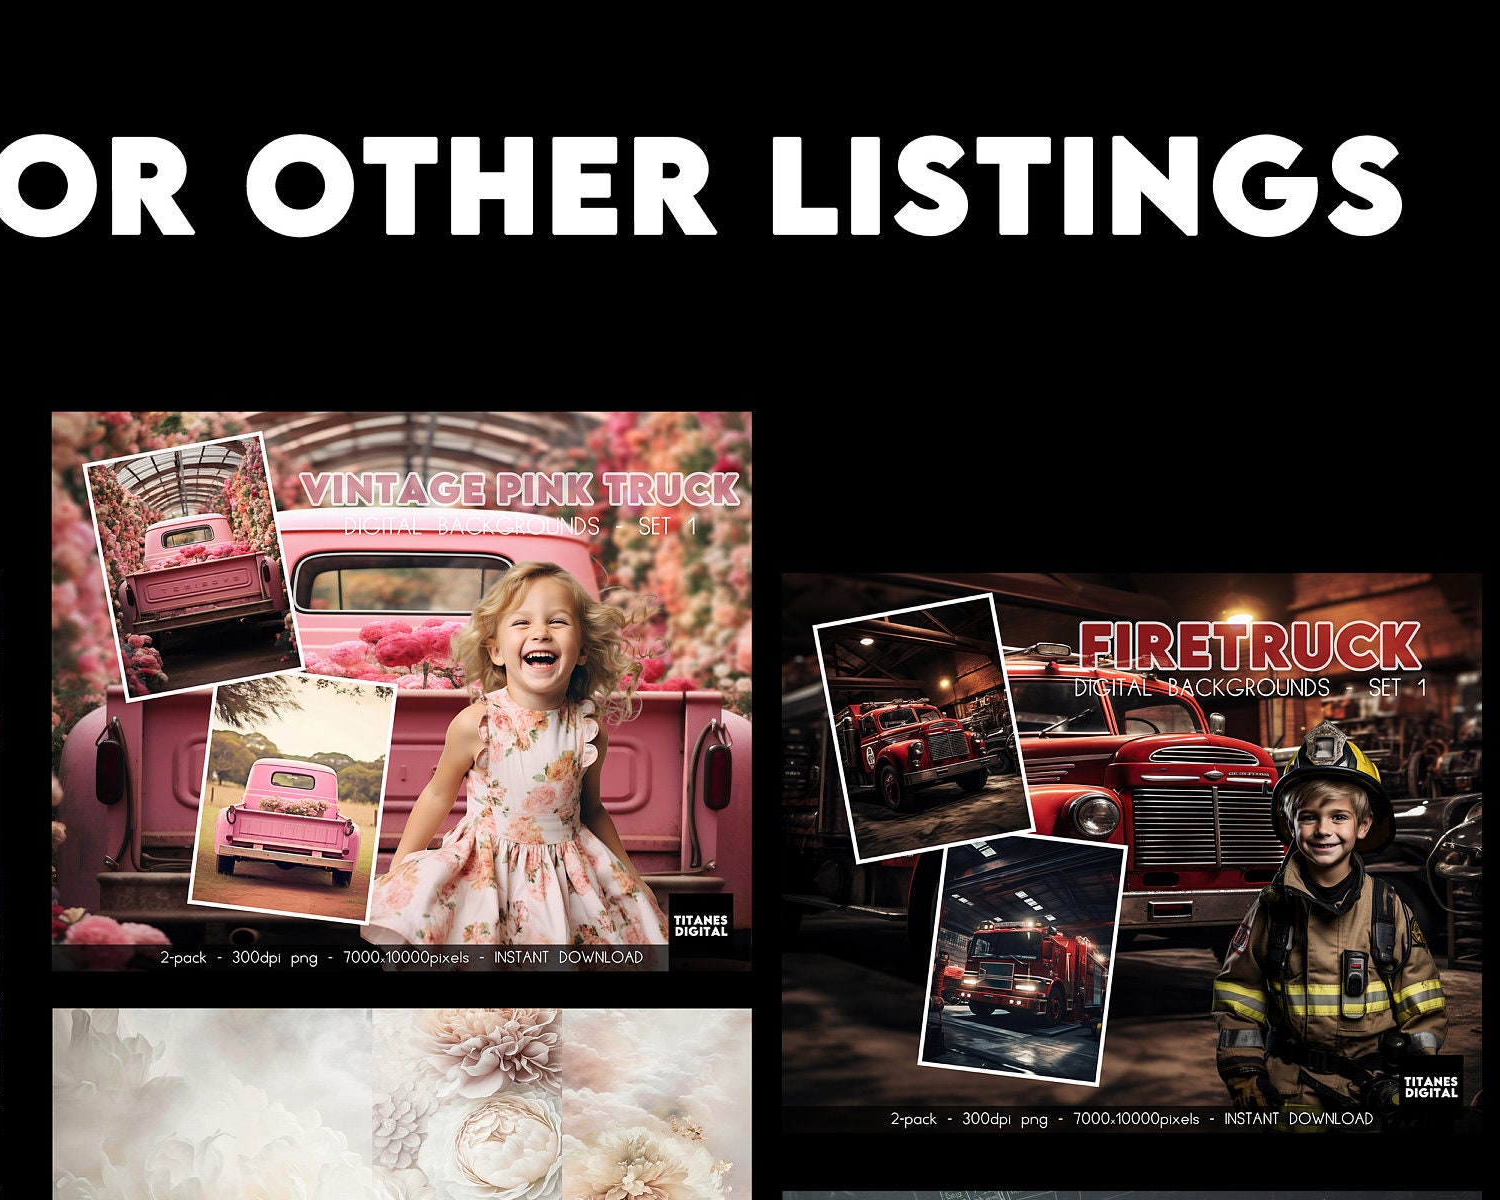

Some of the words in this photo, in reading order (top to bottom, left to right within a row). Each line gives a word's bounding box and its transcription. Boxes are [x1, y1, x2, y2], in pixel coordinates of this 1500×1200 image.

[247, 134, 717, 237] OTHER
[773, 134, 1402, 237] LISTINGS
[299, 471, 487, 508] VINTAGE
[495, 472, 593, 508] PINK
[601, 471, 741, 508] TRUCK
[344, 516, 422, 536] DIGITAL
[438, 516, 600, 536] BACKGROUNDS
[639, 516, 670, 536] SET
[687, 516, 696, 536] 1
[1077, 620, 1423, 672] FIRETRUCK
[1075, 678, 1152, 698] DIGITAL
[1169, 678, 1330, 698] BACKGROUNDS
[1369, 678, 1400, 698] SET
[1418, 678, 1427, 698] 1
[673, 915, 728, 926] TITANES
[674, 926, 729, 937] DIGITAL
[160, 950, 207, 968] 2-pack
[232, 950, 281, 968] 300dpi
[291, 954, 318, 968] png
[494, 950, 550, 964] INSTANT
[559, 950, 644, 964] DOWNLOAD
[1403, 1076, 1458, 1087] TITANES
[1404, 1087, 1459, 1098] DIGITAL
[890, 1111, 937, 1129] 2-pack
[962, 1111, 1011, 1129] 300dpi
[1021, 1116, 1048, 1129] png
[1224, 1111, 1280, 1125] INSTANT
[1289, 1111, 1374, 1125] DOWNLOAD
